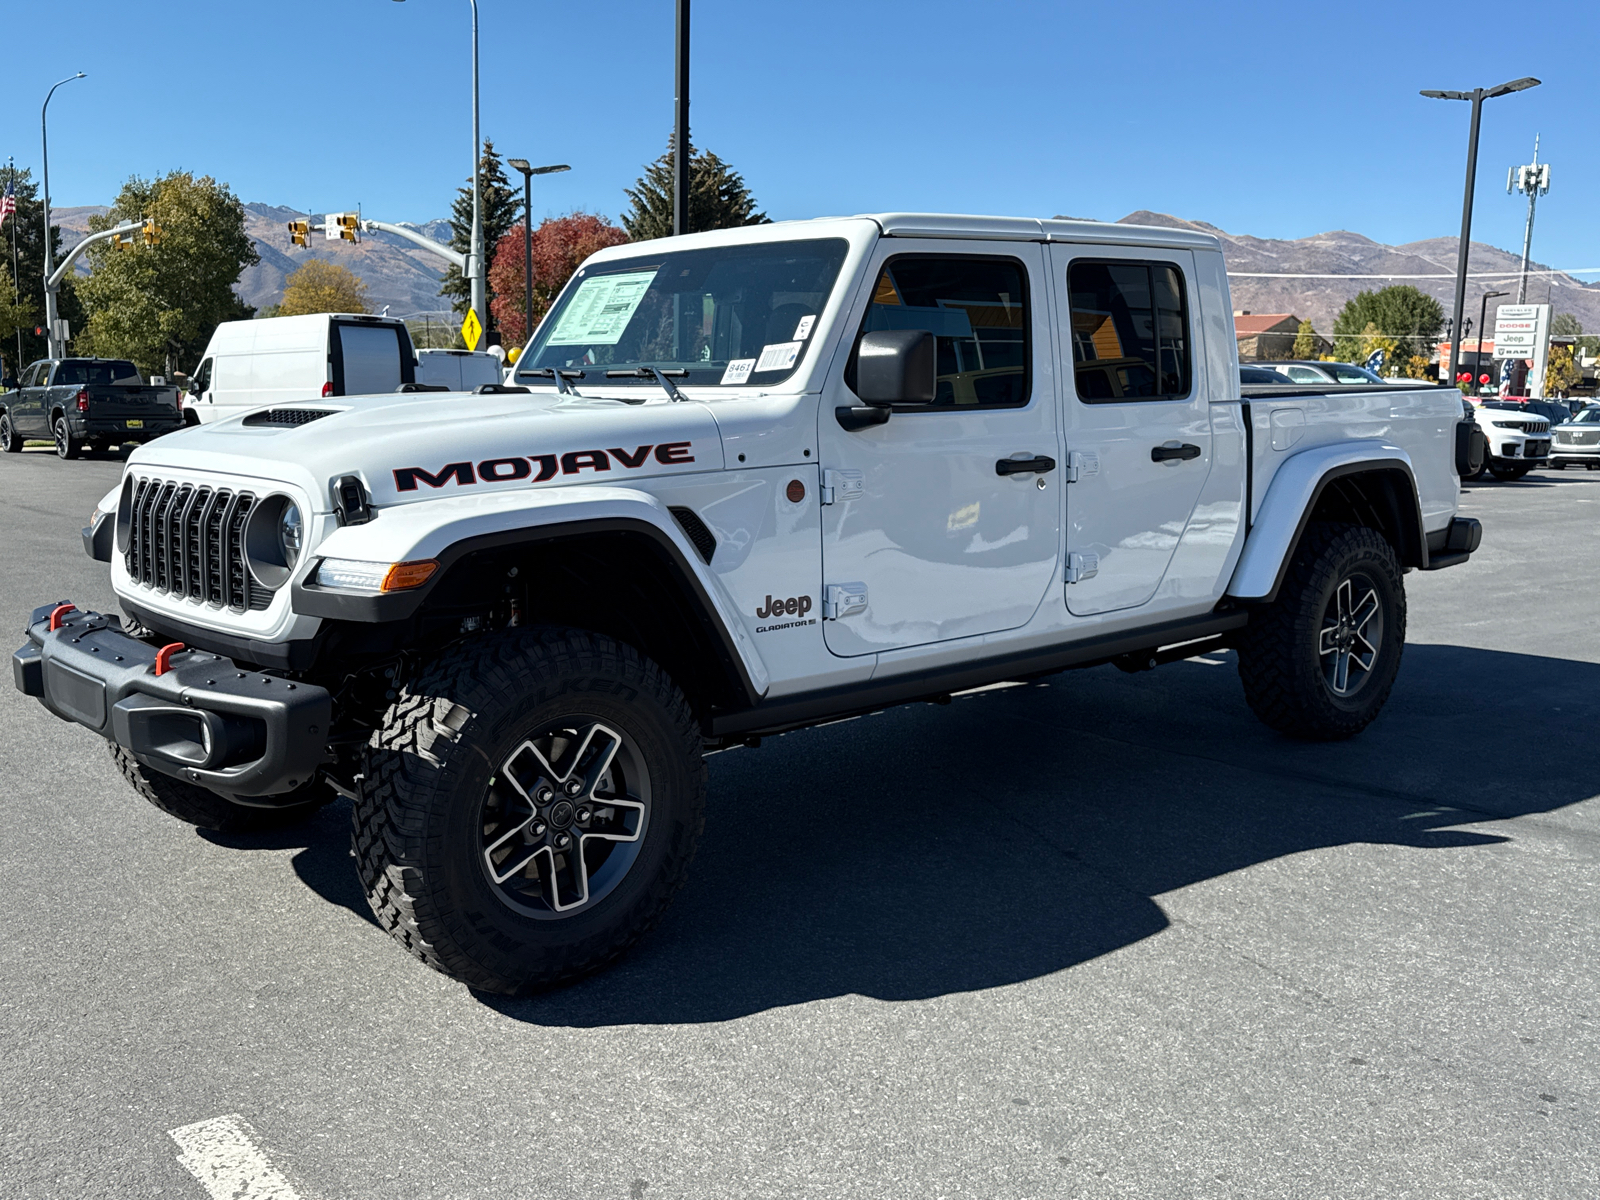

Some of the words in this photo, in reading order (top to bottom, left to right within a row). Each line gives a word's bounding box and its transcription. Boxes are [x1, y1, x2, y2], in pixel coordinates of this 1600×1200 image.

[1503, 334, 1524, 343] Jeep
[728, 363, 751, 373] 8461
[393, 441, 695, 492] MOJAVE
[756, 595, 812, 618] Jeep
[756, 620, 808, 634] GLADIATOR
